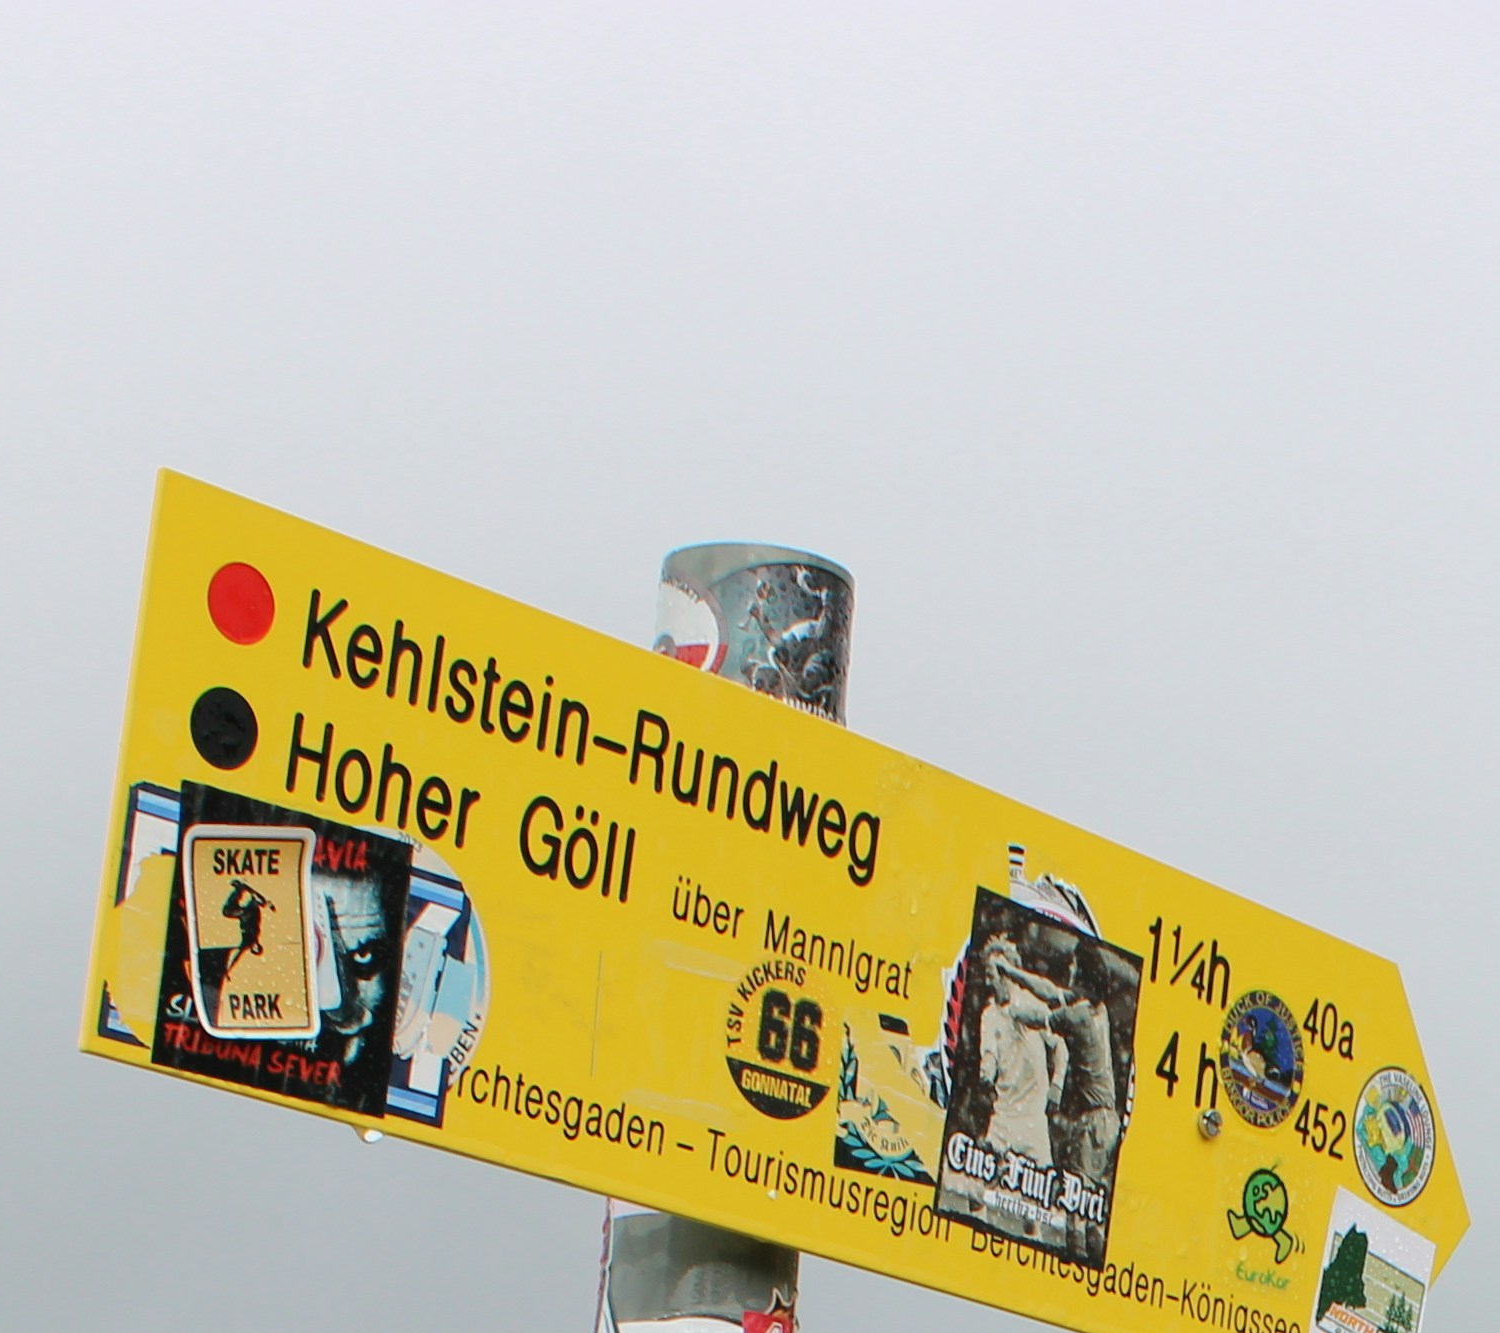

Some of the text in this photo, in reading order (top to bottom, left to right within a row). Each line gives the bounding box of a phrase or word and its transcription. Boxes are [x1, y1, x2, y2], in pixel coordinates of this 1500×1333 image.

[302, 588, 881, 886] Kehlstein-Rundweg
[212, 848, 282, 876] SKATE
[285, 711, 913, 1001] Hoher Göll über Mannlgrat
[228, 993, 283, 1021] PARK
[726, 959, 807, 1048] TSV KICKERS
[756, 986, 823, 1073] 66
[1302, 997, 1355, 1061] 40a
[266, 1050, 342, 1088] SEVER
[740, 1068, 813, 1109] GONNATAL
[1155, 1030, 1220, 1110] 4 h
[457, 1062, 667, 1157] rchtesgaden
[707, 1128, 951, 1241] Tourismusregion
[1293, 1098, 1348, 1161] 452
